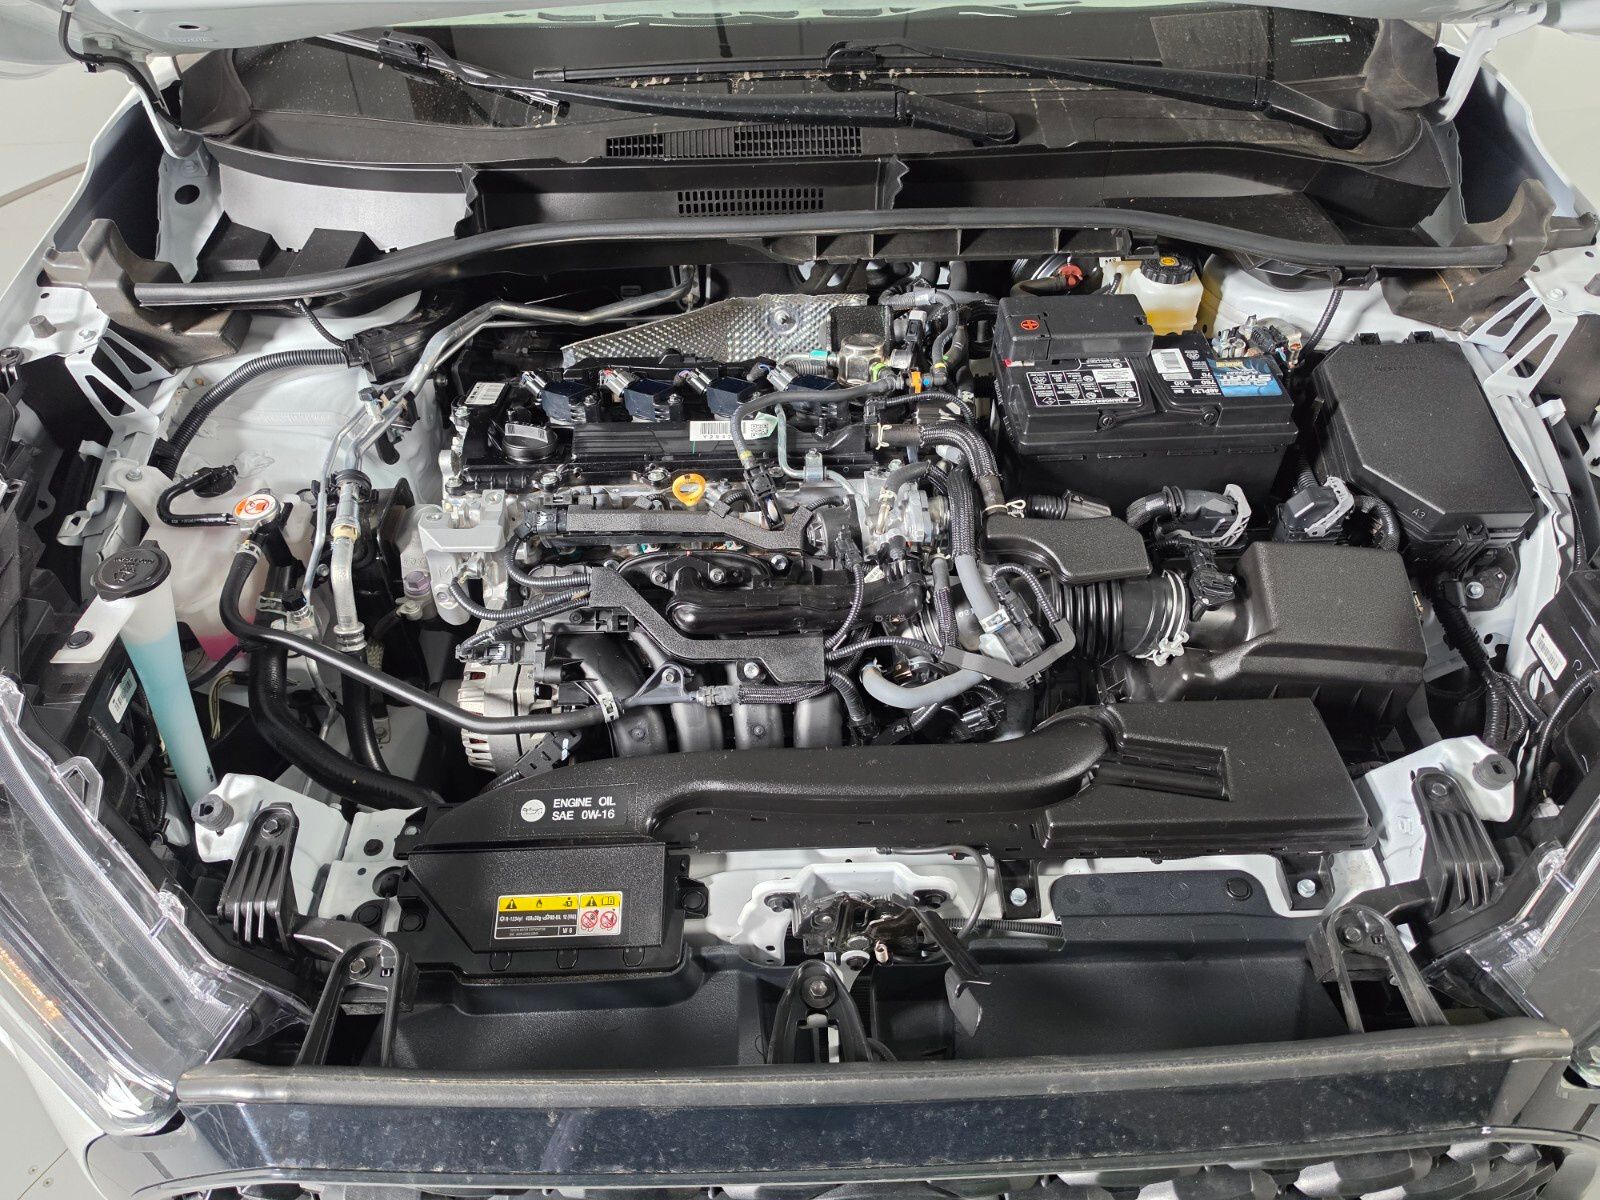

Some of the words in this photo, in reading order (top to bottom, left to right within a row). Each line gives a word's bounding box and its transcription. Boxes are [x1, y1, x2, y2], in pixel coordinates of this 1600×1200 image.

[1412, 508, 1426, 519] A3
[552, 797, 592, 809] ENGINE
[598, 795, 616, 807] OIL
[551, 810, 574, 821] SAE
[581, 808, 616, 820] 0W-16
